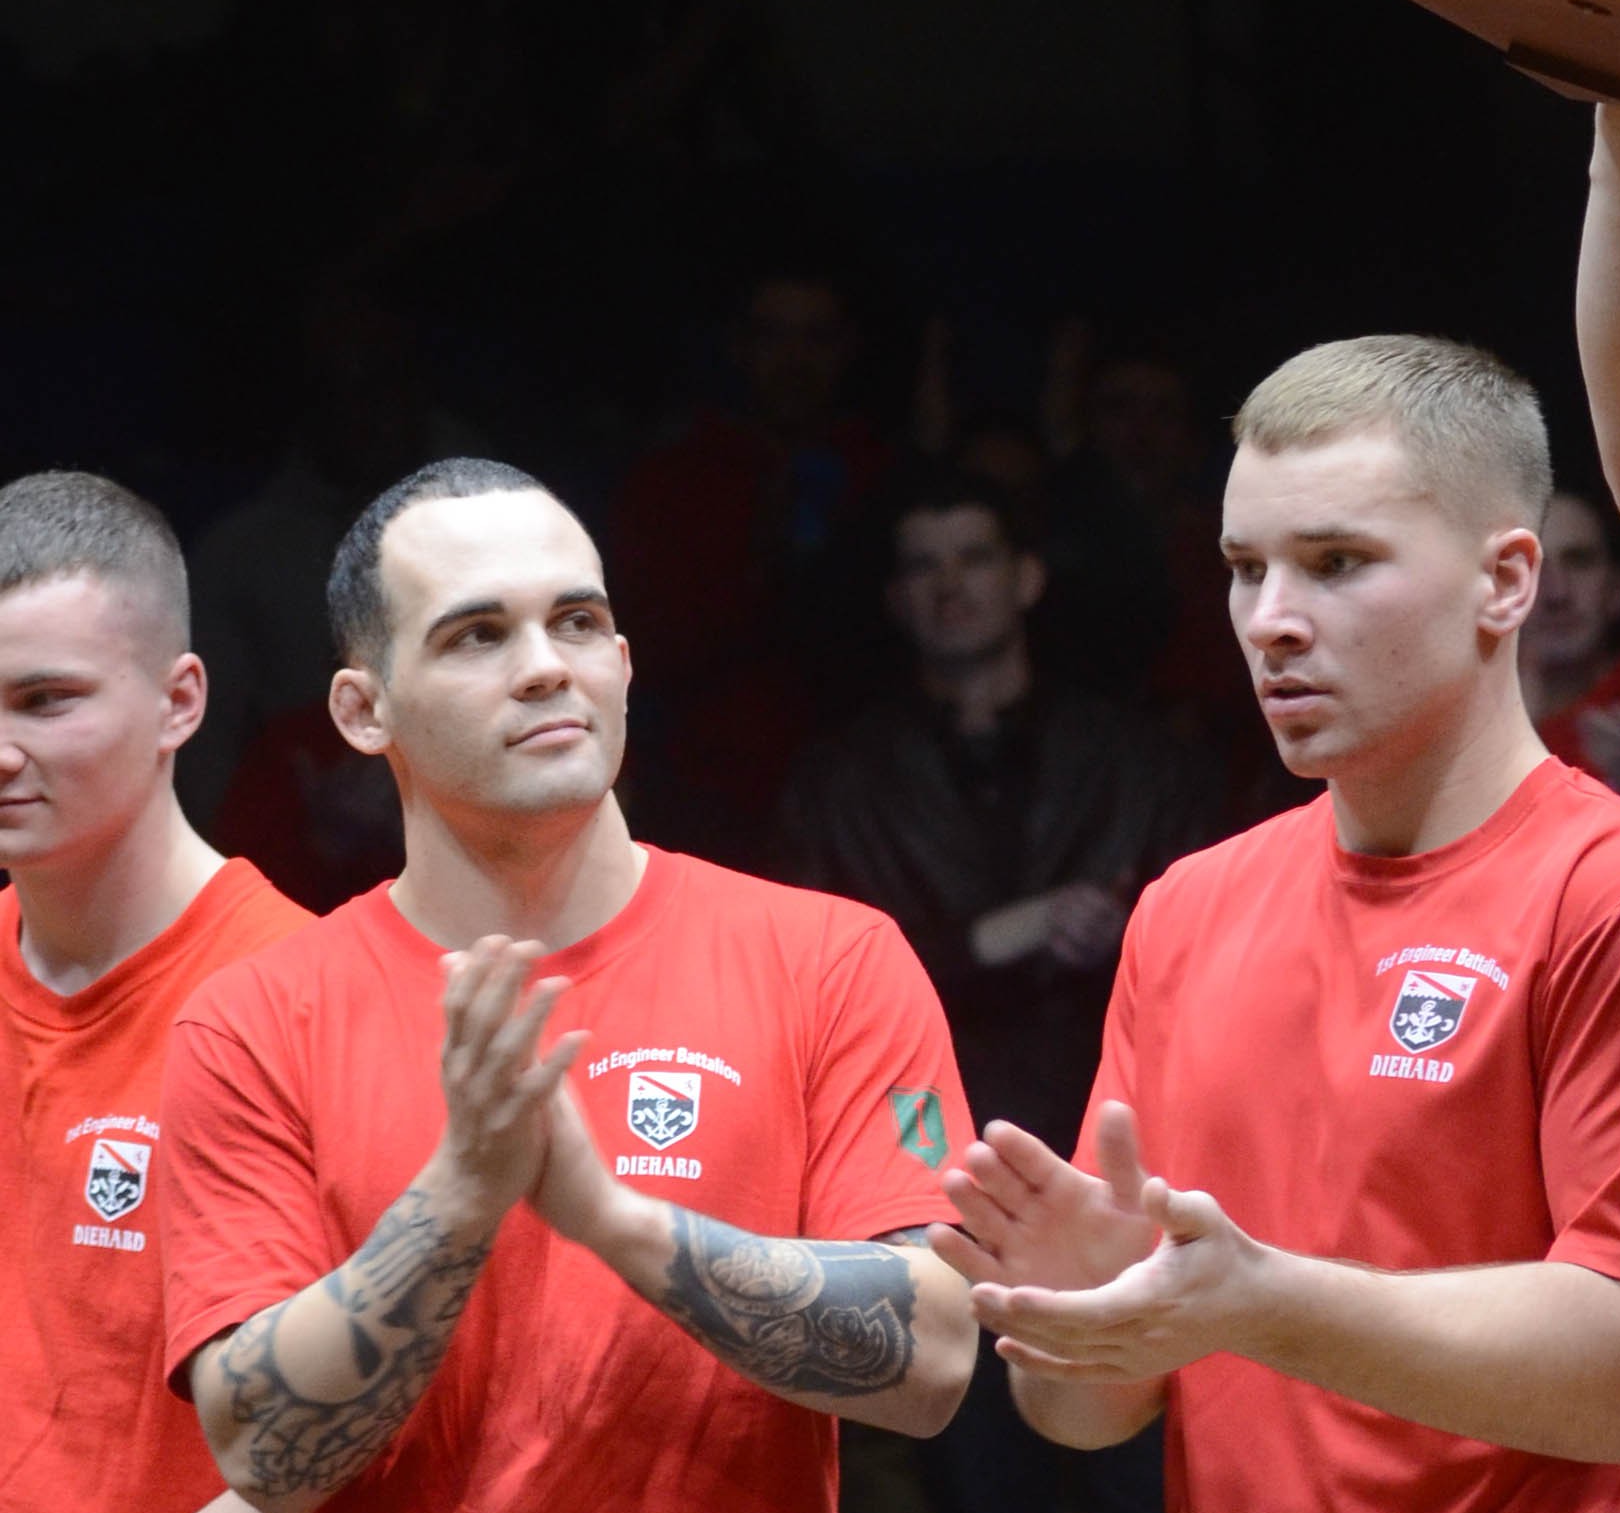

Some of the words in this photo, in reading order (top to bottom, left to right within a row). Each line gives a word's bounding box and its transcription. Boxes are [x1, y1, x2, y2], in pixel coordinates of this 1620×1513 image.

[1376, 952, 1398, 977] 1st
[1397, 944, 1457, 965] Engineer
[1455, 948, 1510, 991] Battalion
[588, 1057, 609, 1080] 1st
[609, 1048, 676, 1069] Engineer
[676, 1047, 742, 1087] Battalion
[1369, 1054, 1454, 1083] DIEHARD
[81, 1114, 137, 1135] Engineer
[616, 1155, 702, 1180] DIEHARD
[72, 1223, 146, 1253] DIEHARD
